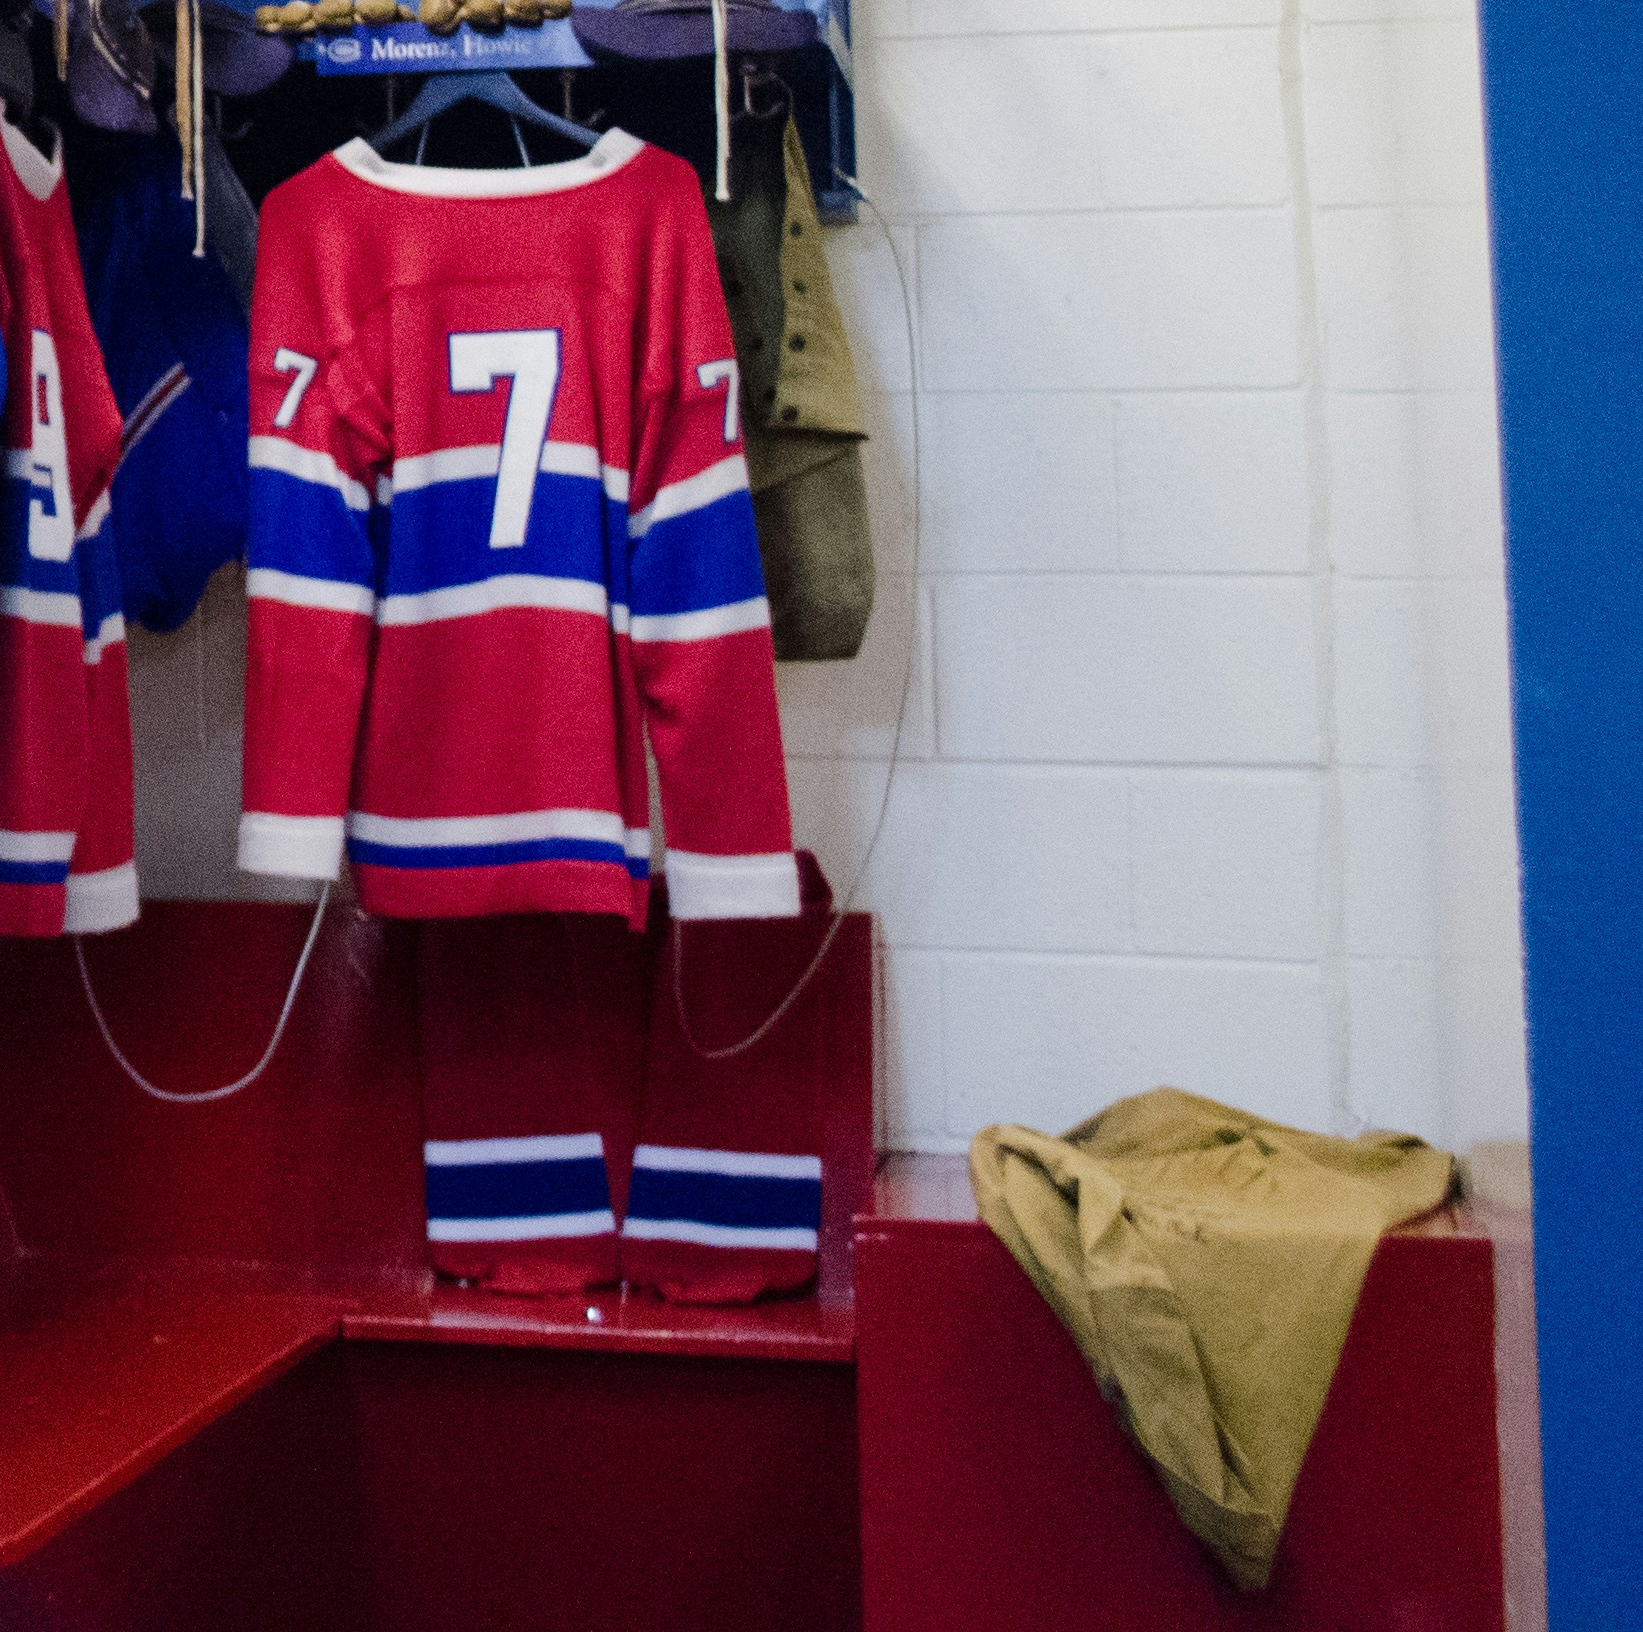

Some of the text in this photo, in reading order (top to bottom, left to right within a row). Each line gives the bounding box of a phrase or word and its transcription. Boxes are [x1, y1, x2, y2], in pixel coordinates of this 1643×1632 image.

[273, 347, 318, 429] 7
[696, 358, 740, 443] 7
[448, 327, 563, 550] 7
